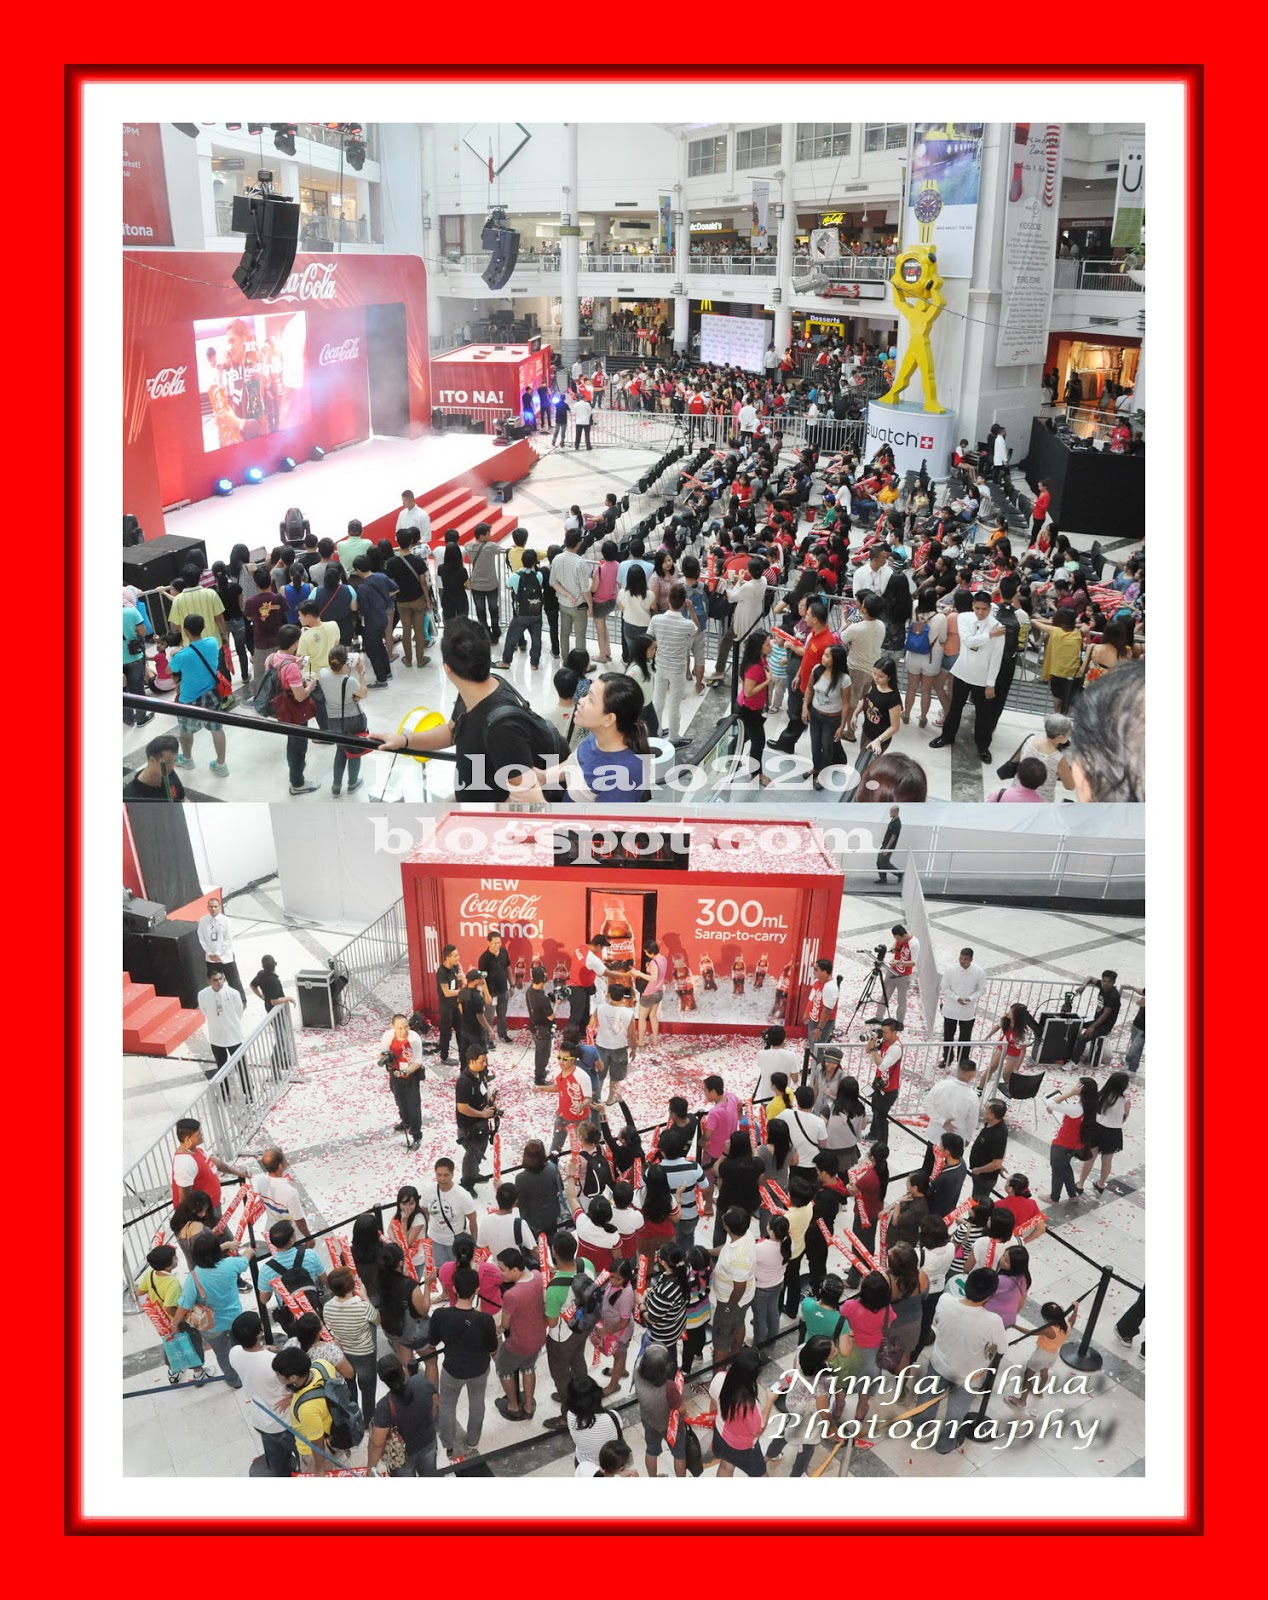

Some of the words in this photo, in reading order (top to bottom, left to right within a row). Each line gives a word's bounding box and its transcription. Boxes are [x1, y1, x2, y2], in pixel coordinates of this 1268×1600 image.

[810, 315, 840, 324] Desserts
[319, 337, 361, 366] Coca-Cola
[439, 390, 468, 403] ITO
[473, 390, 504, 404] NA!
[866, 423, 918, 448] swatch
[480, 878, 519, 891] NEW
[460, 892, 544, 920] Coca-Cola
[695, 898, 788, 929] 300mL
[460, 919, 544, 939] mismo!
[694, 928, 787, 944] Sarap-to-carry
[832, 1236, 857, 1263] Coca-Cola
